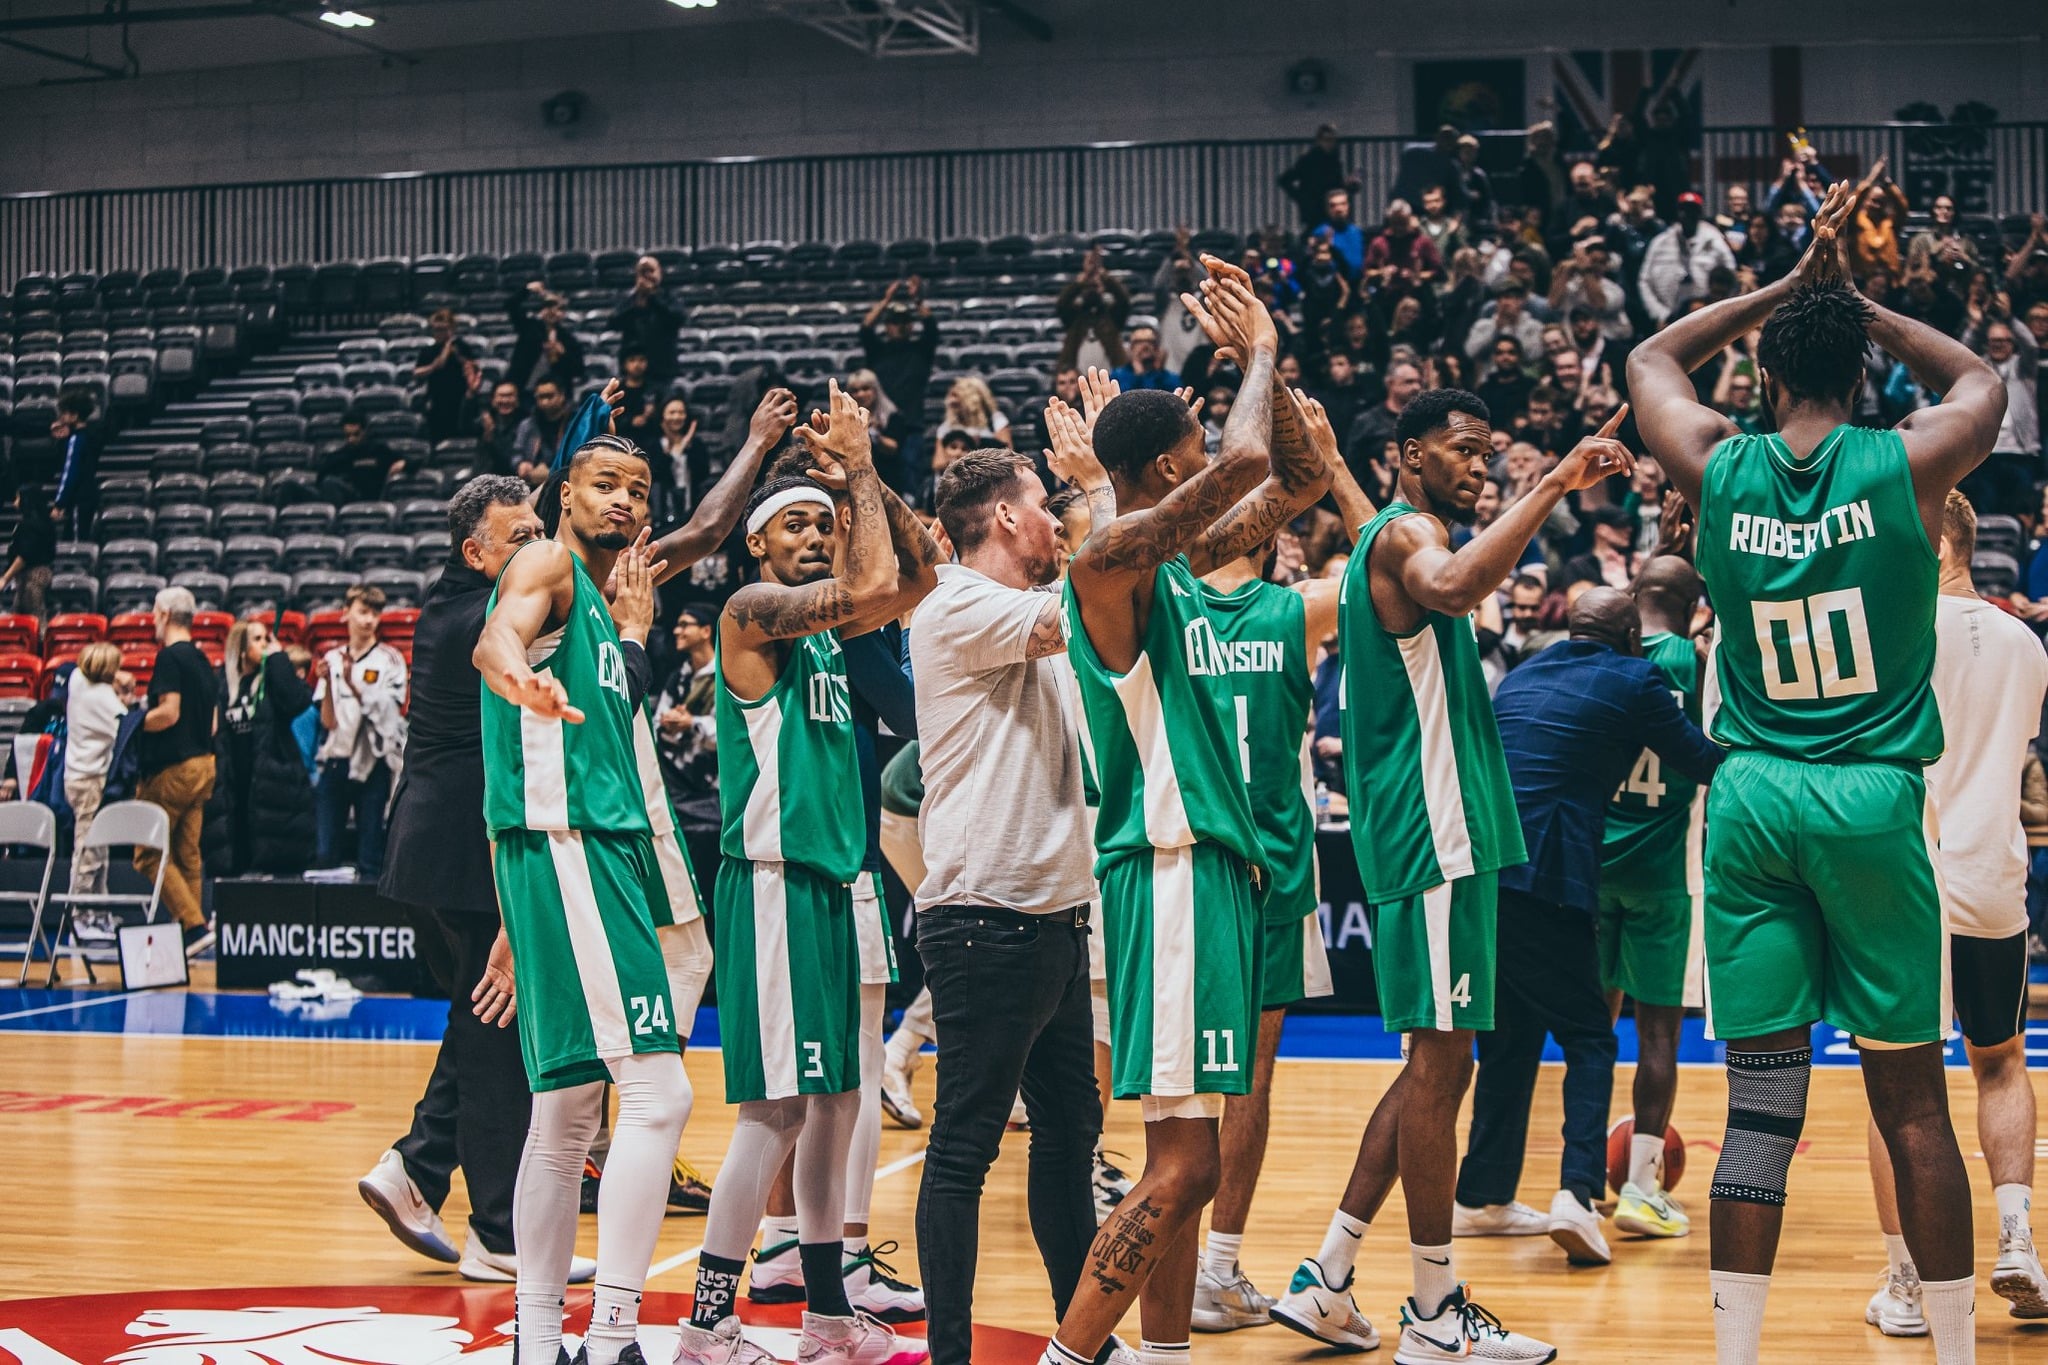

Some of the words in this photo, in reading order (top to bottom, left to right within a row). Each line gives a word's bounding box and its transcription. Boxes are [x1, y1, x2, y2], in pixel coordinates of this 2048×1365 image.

[1751, 586, 1878, 700] 00
[1612, 746, 1666, 807] 4
[222, 923, 416, 959] MANCHESTER
[1451, 973, 1471, 1008] 4
[630, 994, 669, 1035] 24
[803, 1041, 824, 1077] 3
[1202, 1029, 1239, 1071] 11
[1092, 1232, 1146, 1275] CHRIST
